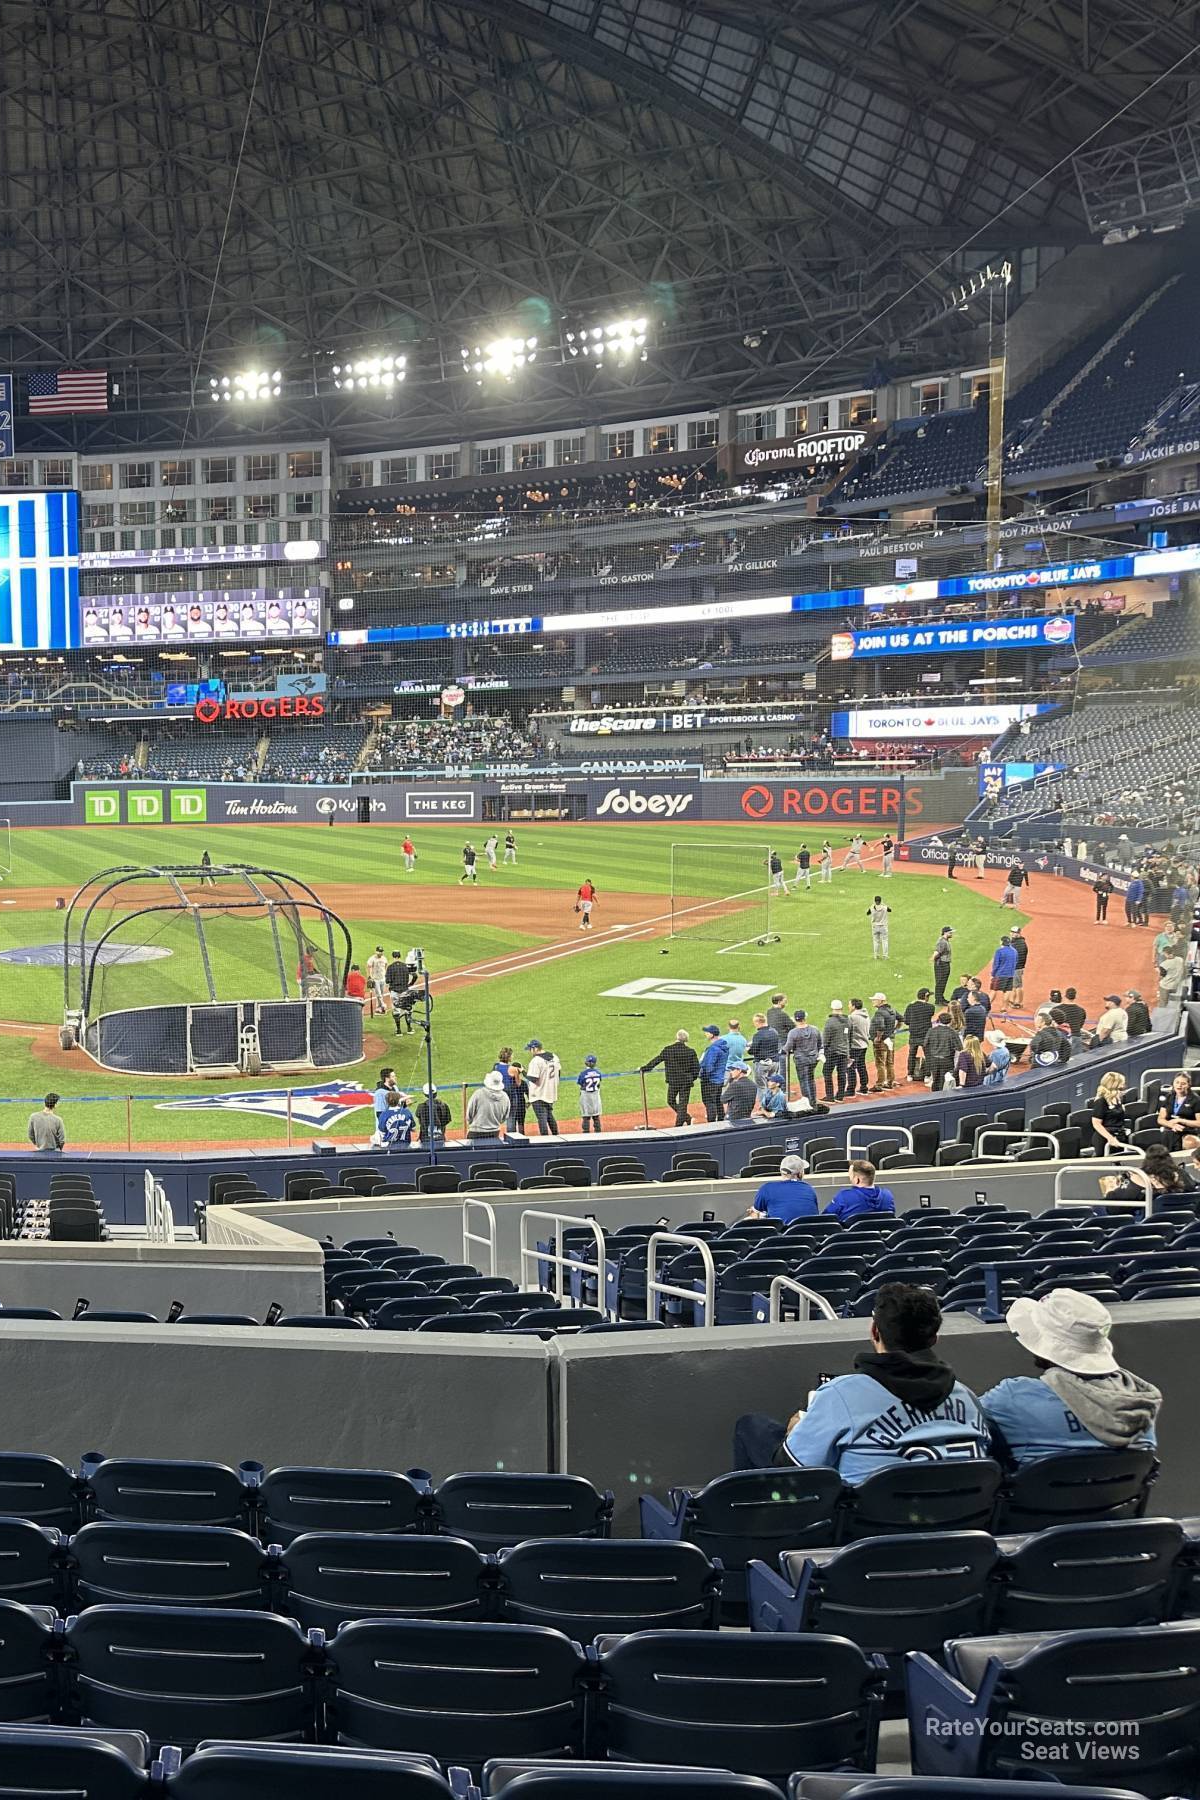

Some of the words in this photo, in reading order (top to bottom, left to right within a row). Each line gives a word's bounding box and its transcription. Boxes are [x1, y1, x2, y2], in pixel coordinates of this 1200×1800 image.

[745, 447, 795, 467] Corona
[797, 435, 865, 458] ROOFTOP
[816, 453, 846, 463] PATIO
[1139, 444, 1175, 461] JACKIE
[1149, 501, 1178, 517] JOSÉ
[1000, 529, 1018, 539] ROY
[1021, 520, 1072, 537] HALLADAY
[860, 547, 880, 557] PAUL
[883, 541, 924, 553] BEESTON
[728, 564, 743, 572] PAT
[745, 560, 778, 571] GILLICK
[600, 577, 618, 585] CITO
[621, 573, 654, 583] GASTON
[968, 575, 1026, 592] TORONTO
[1040, 570, 1069, 582] BLUE
[1071, 565, 1101, 580] JAYS
[490, 587, 509, 595] DAVE
[512, 585, 533, 593] STIEB
[858, 635, 886, 650] JOIN
[890, 633, 909, 648] US
[913, 631, 935, 646] AT
[938, 629, 967, 644] THE
[973, 625, 1037, 642] PORCH!
[394, 685, 426, 693] CANADA
[426, 684, 441, 692] DRY
[468, 680, 509, 690] BLEACHERS
[224, 697, 325, 719] ROGERS
[570, 717, 656, 733] theScore
[672, 713, 705, 729] BET
[709, 715, 758, 724] SPORTSBOOK
[767, 714, 796, 722] CASINO
[868, 718, 921, 728] TORONTO
[971, 715, 1000, 726] JAYS
[580, 760, 649, 774] CANADA
[89, 796, 116, 816] TD
[131, 796, 159, 816] TD
[174, 795, 202, 815] TD
[225, 800, 248, 815] Tim
[249, 799, 298, 815] Hortons
[413, 800, 438, 809] THE
[443, 800, 466, 809] KEG
[596, 788, 693, 817] Sobeys
[783, 787, 924, 815] ROGERS
[921, 848, 949, 860] Officia
[585, 1078, 601, 1092] 27
[389, 1126, 409, 1141] 27
